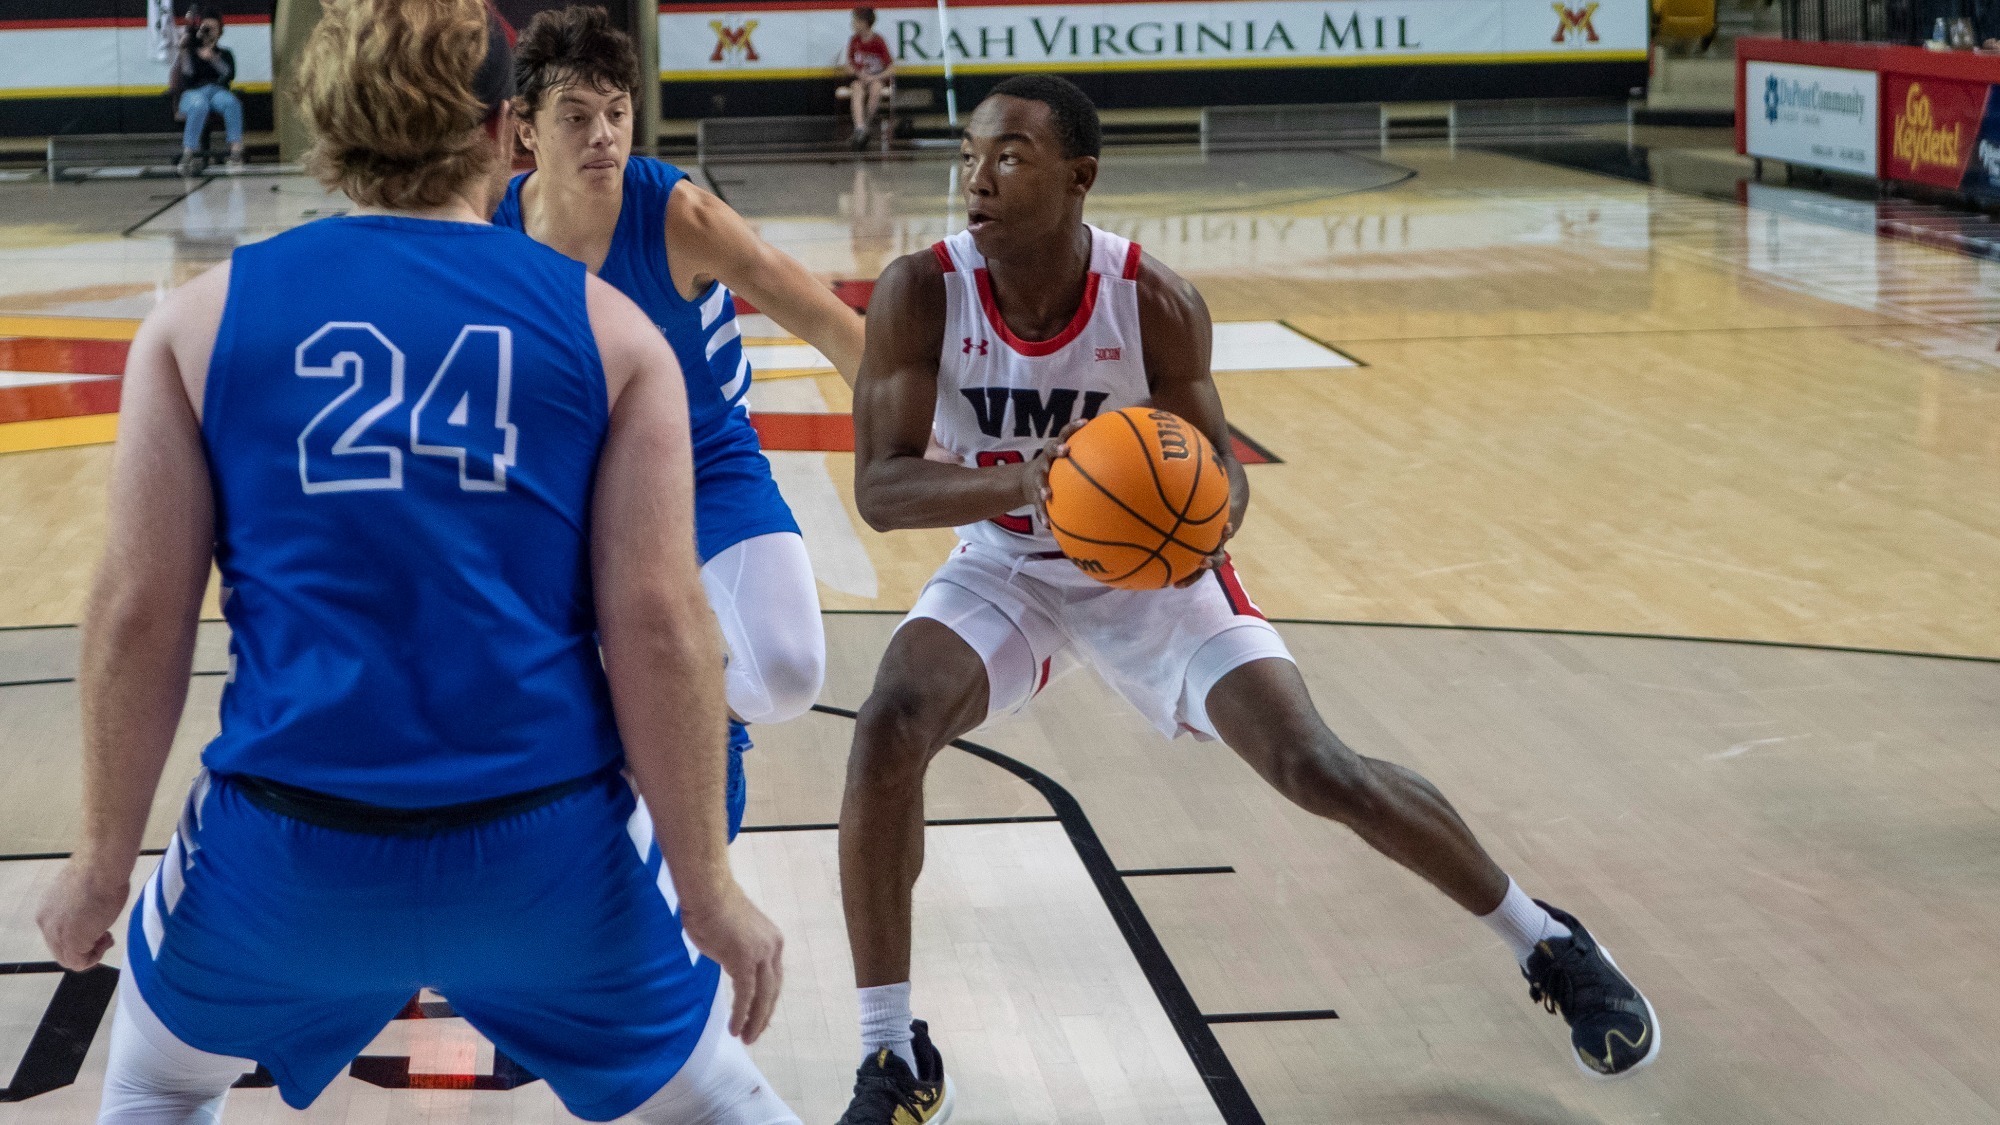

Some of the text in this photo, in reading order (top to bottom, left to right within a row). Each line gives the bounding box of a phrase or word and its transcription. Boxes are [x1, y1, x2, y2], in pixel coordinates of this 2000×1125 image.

[1028, 15, 1297, 56] VIRGINIA
[1318, 9, 1421, 50] MIL
[1892, 114, 1961, 173] Keydets!
[295, 320, 518, 495] 24
[959, 386, 1110, 439] VMI
